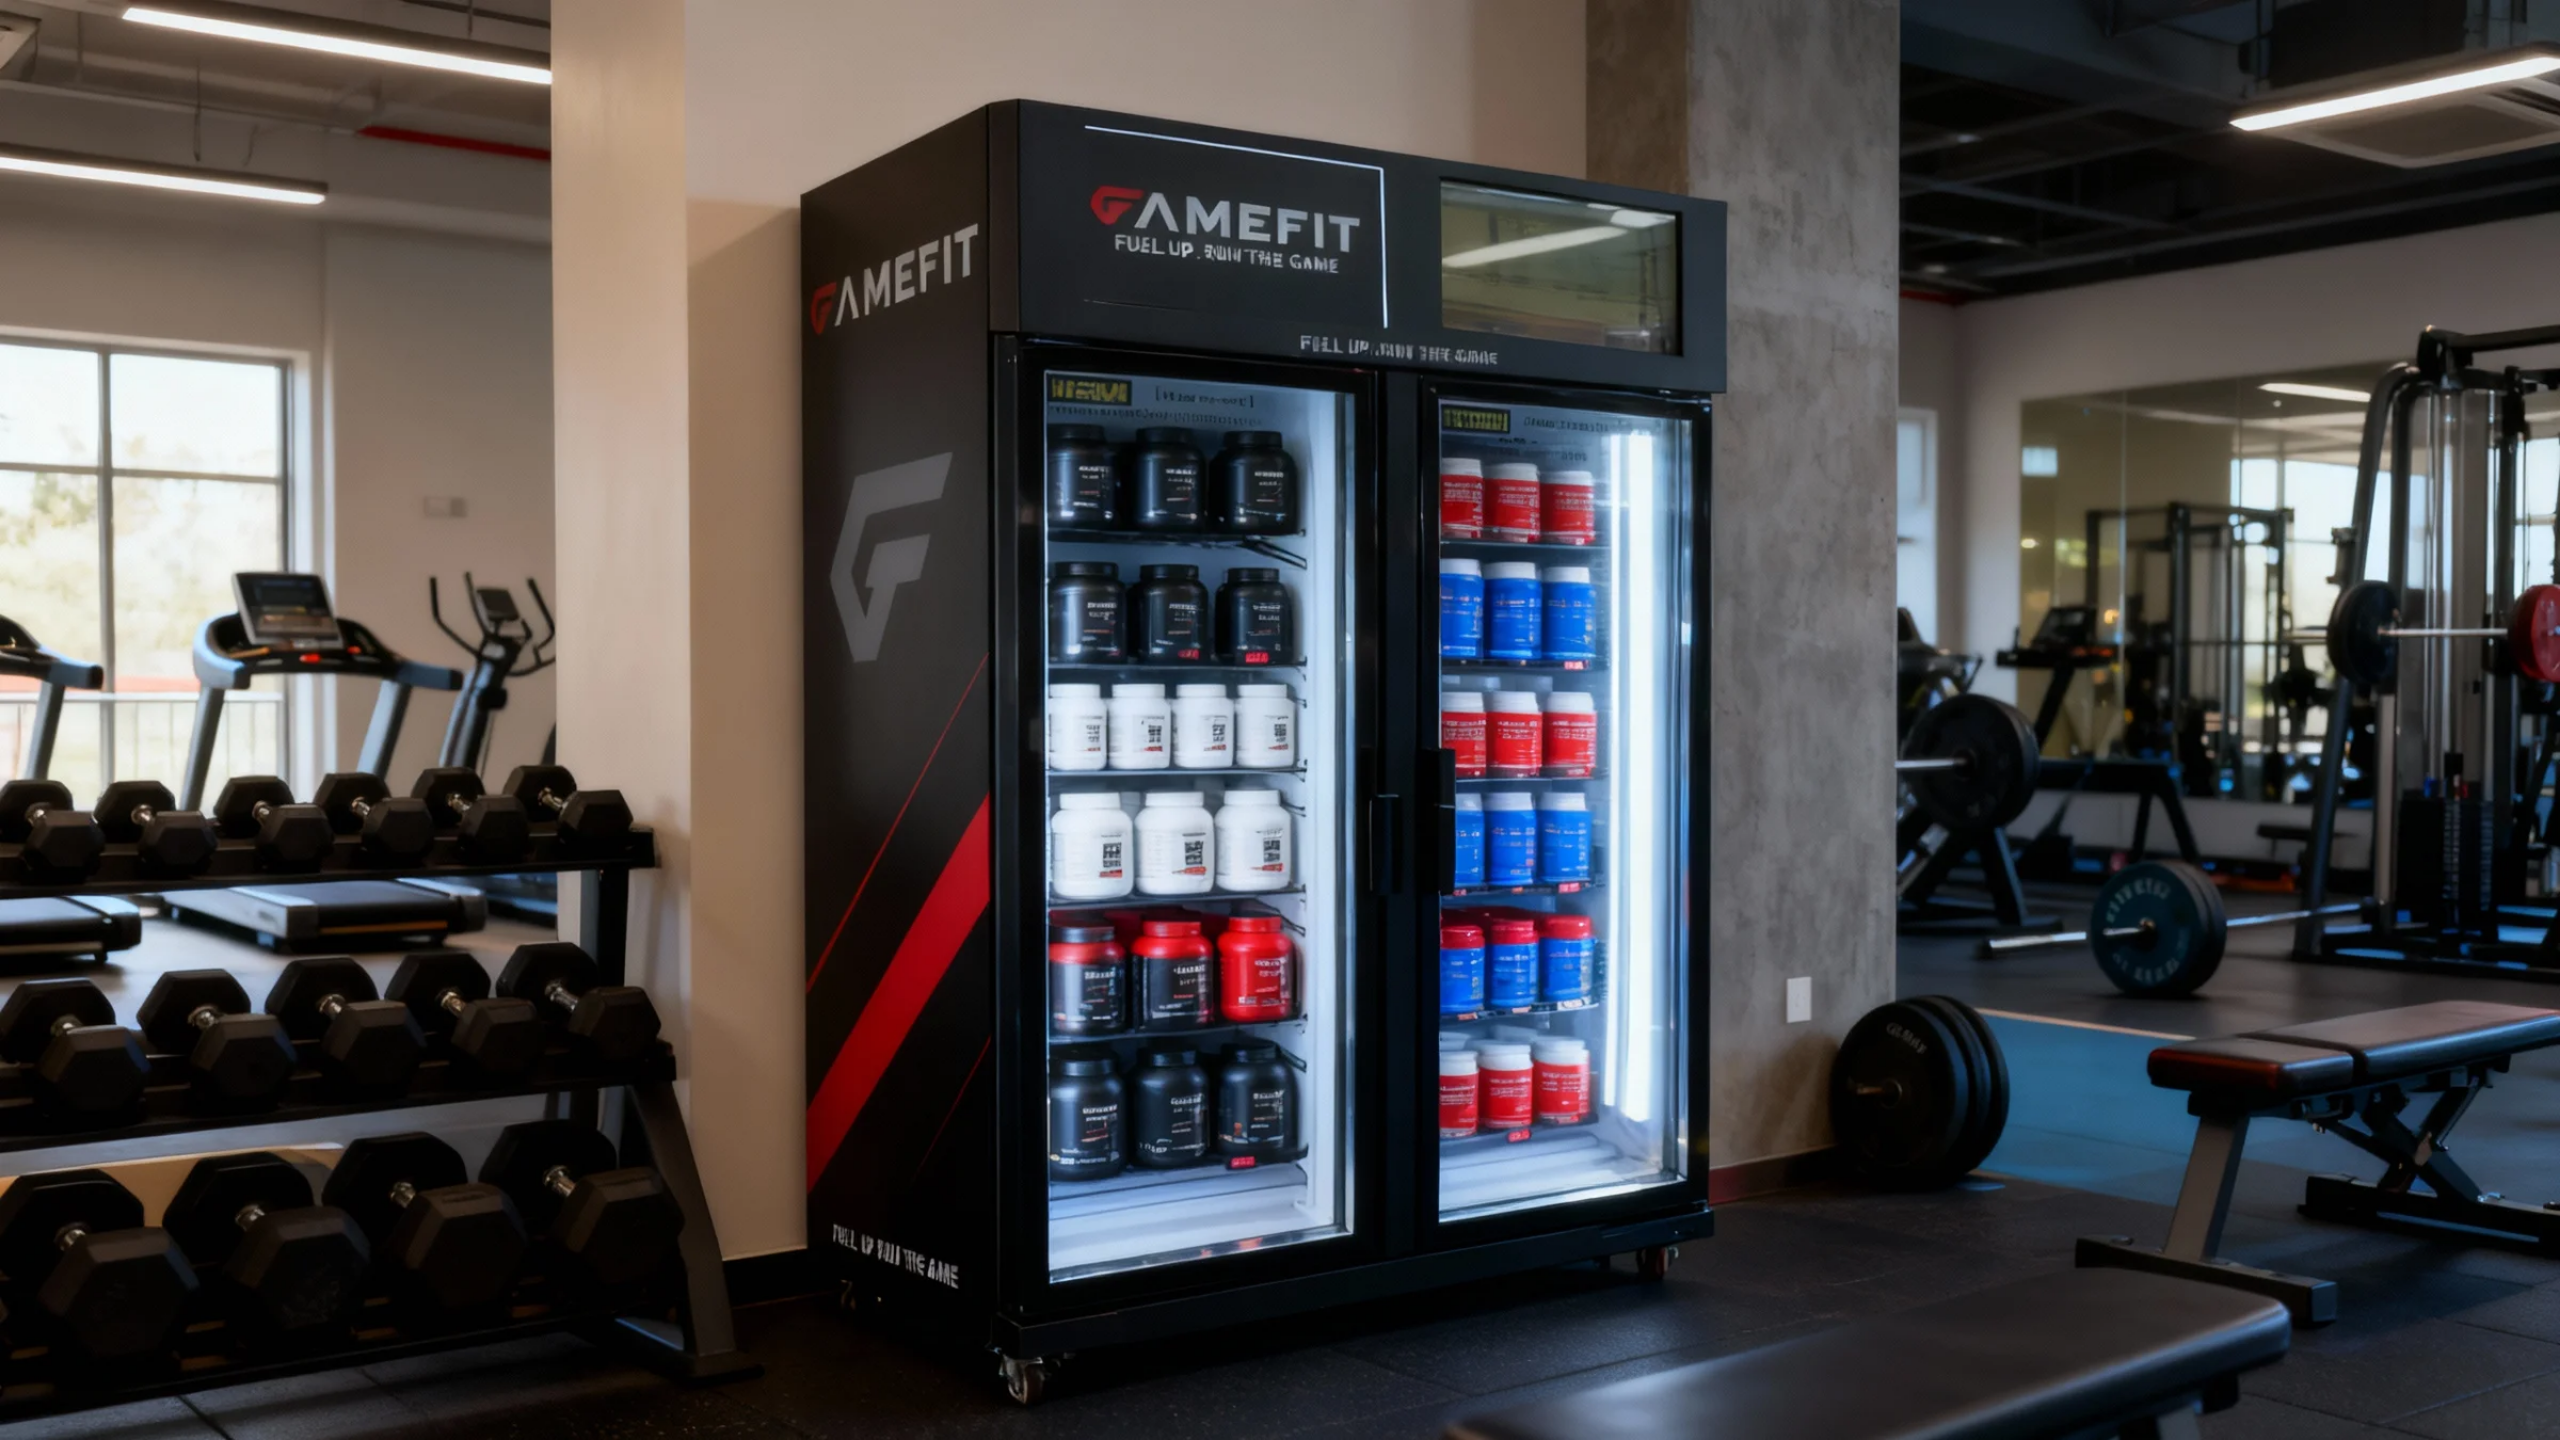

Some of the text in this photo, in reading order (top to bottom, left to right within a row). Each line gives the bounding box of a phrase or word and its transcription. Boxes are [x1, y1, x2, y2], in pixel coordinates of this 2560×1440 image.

[1090, 185, 1361, 253] GAMEFIT
[809, 223, 979, 335] GAMEFIT
[1114, 234, 1165, 255] FUEL
[1289, 254, 1339, 274] GAME
